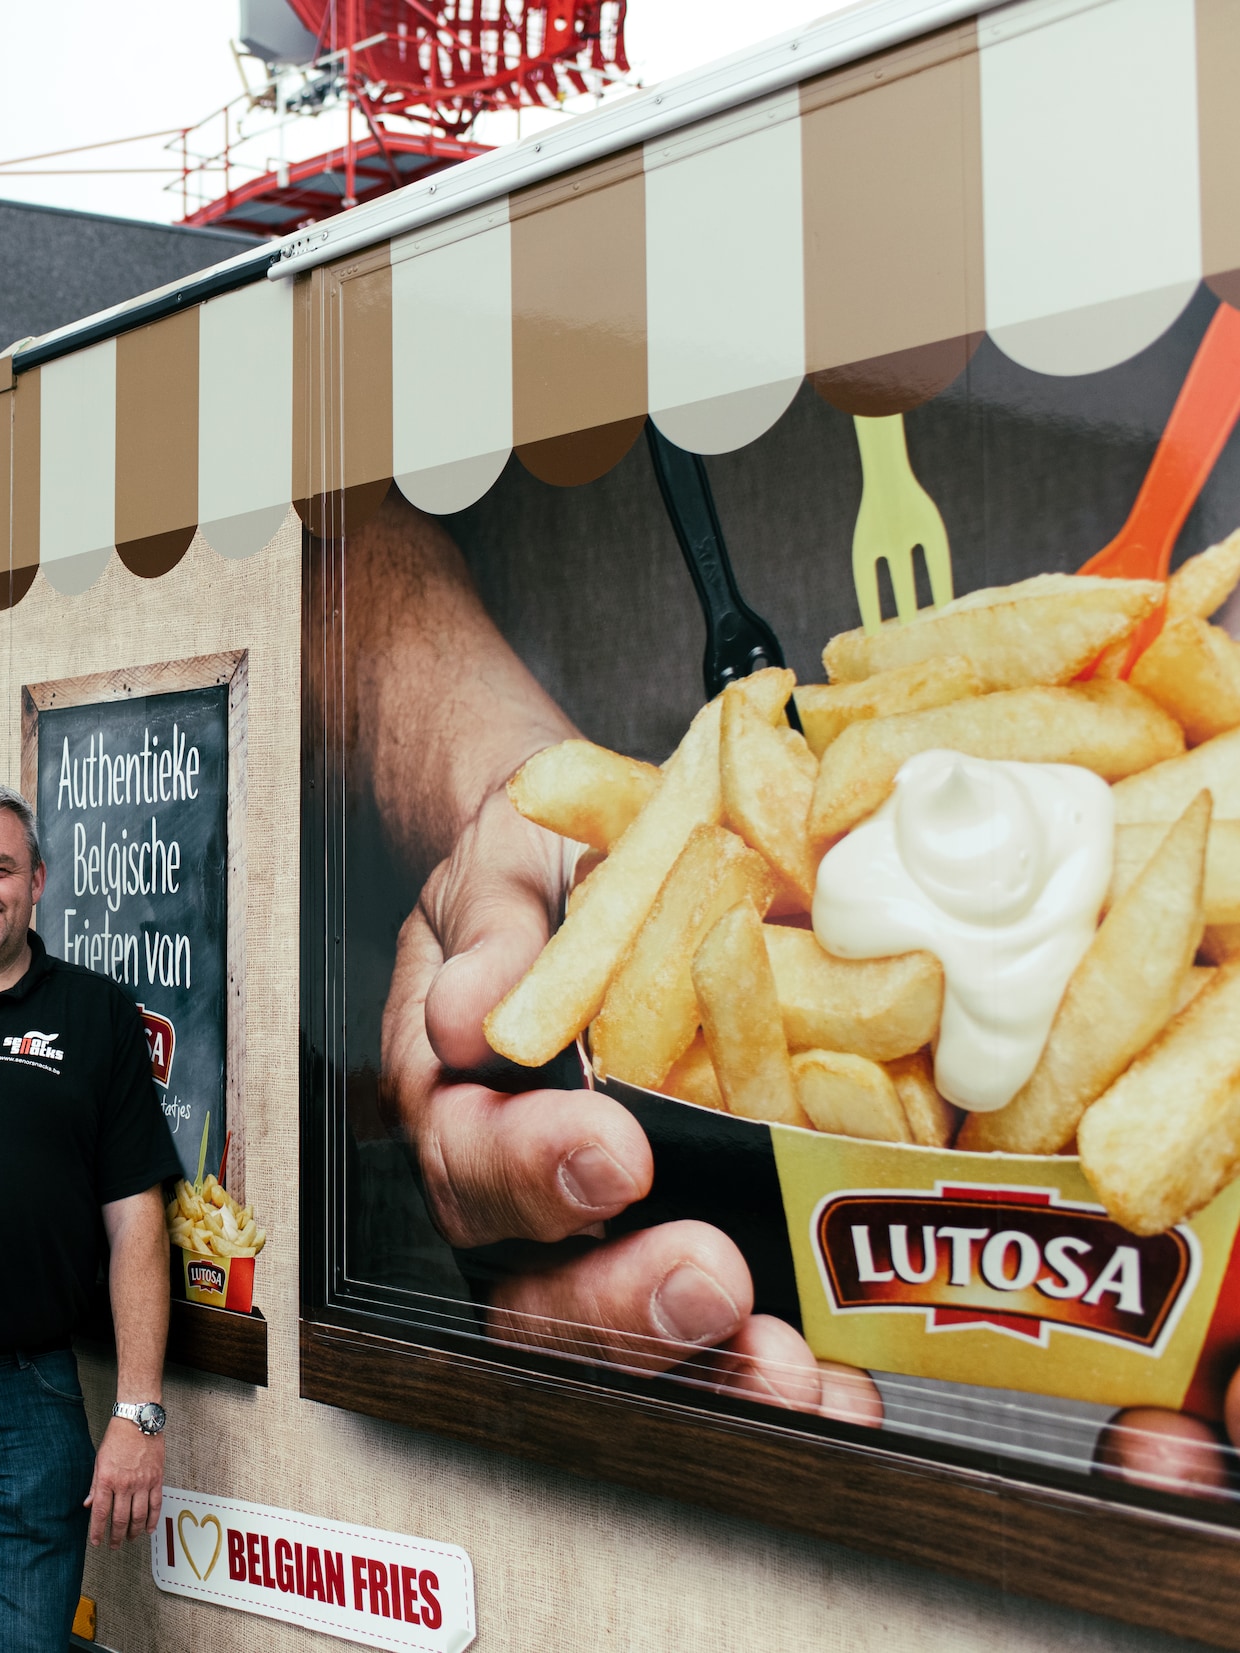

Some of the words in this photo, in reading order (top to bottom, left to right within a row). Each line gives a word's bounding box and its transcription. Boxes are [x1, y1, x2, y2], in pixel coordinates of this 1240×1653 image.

[58, 723, 200, 810] Authentieke
[74, 816, 181, 912] Belgische
[145, 931, 191, 989] van
[161, 1094, 191, 1134] tatjes
[190, 1266, 223, 1287] LUTOSA
[850, 1224, 1145, 1315] LUTOSA
[165, 1517, 175, 1567] I
[227, 1528, 346, 1607] BELGIAN
[351, 1555, 442, 1630] FRIES
